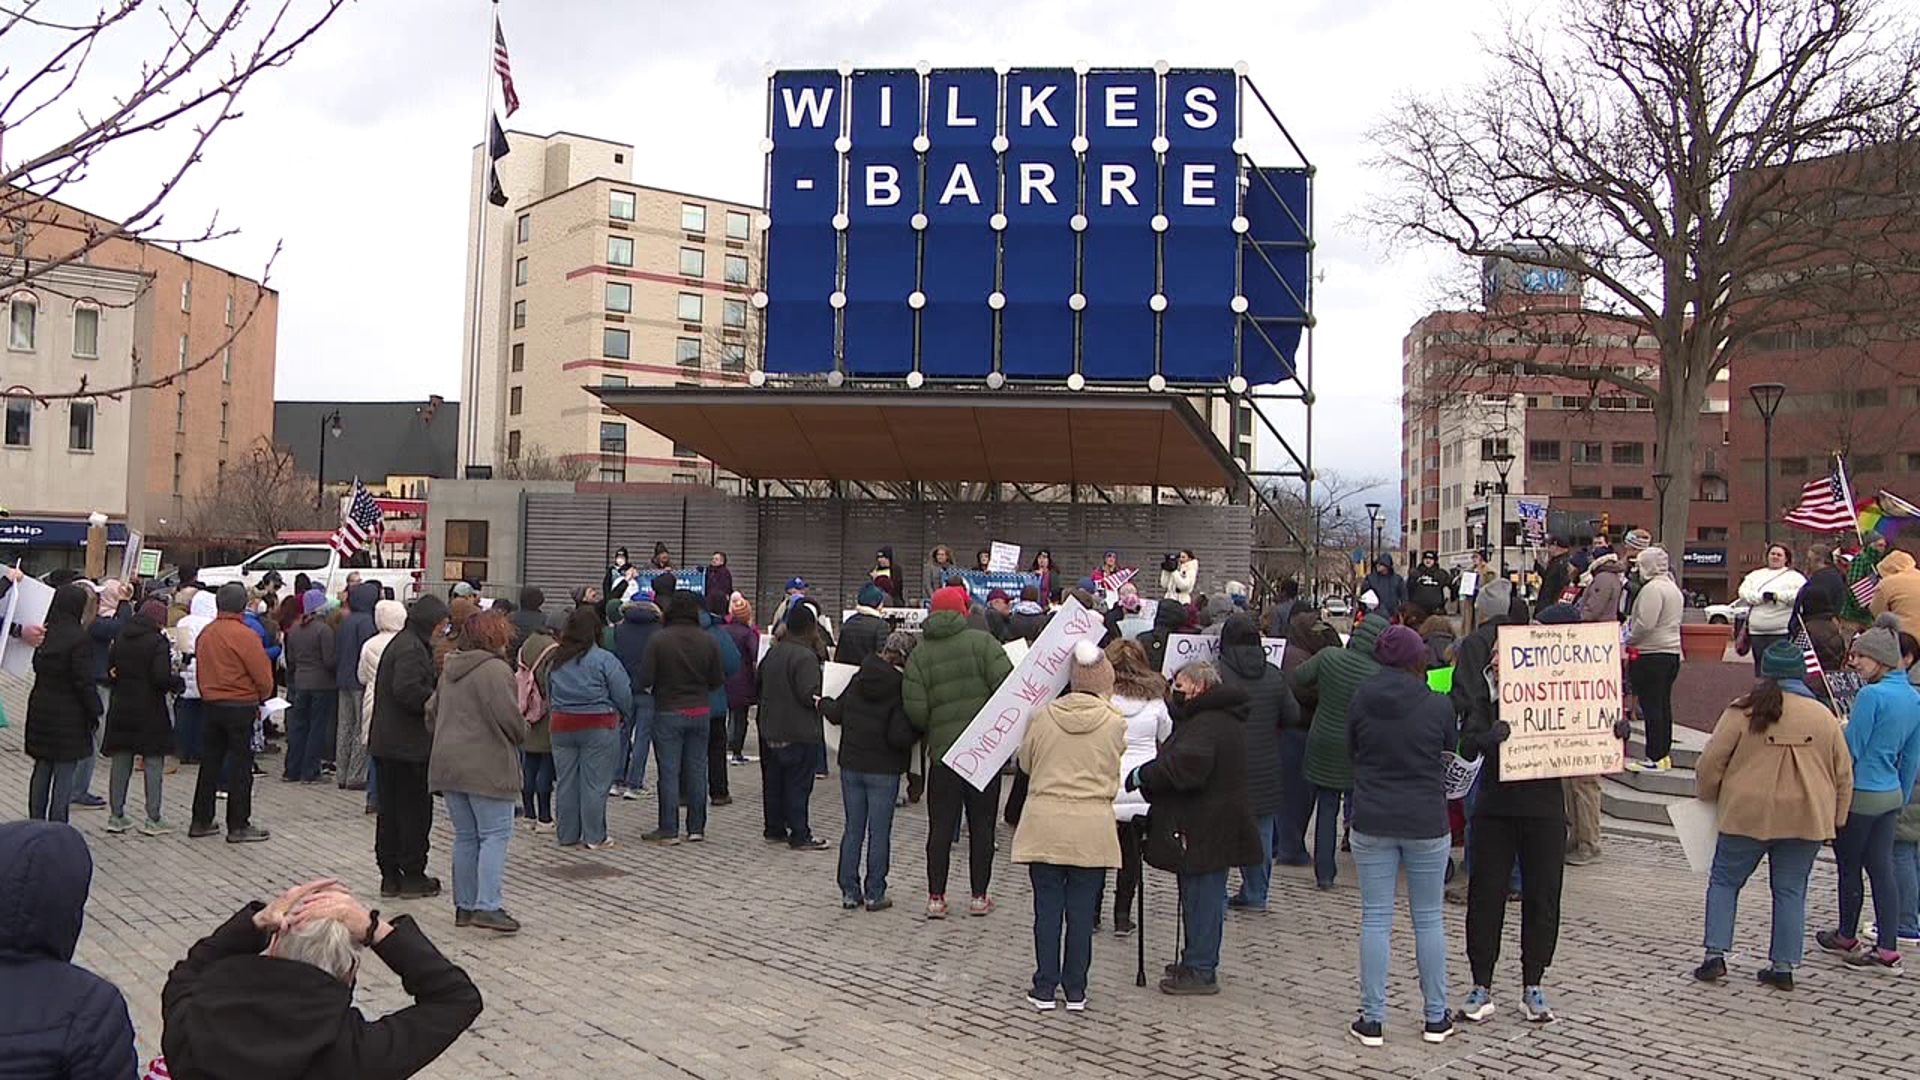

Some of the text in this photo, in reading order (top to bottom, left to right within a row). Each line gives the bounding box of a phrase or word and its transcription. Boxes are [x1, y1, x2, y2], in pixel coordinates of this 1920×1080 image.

[781, 86, 1219, 129] WILKES
[1693, 553, 1722, 562] Security
[1566, 628, 1578, 639] for
[1177, 639, 1201, 655] Our
[1511, 643, 1614, 669] DEMOCRACY
[1011, 673, 1051, 702] WE
[1034, 643, 1076, 677] FALL
[1551, 669, 1566, 677] our
[1502, 678, 1618, 704] CONSTITUTION
[1523, 706, 1567, 732] RULE
[1571, 711, 1582, 724] of
[1586, 707, 1621, 729] LAW
